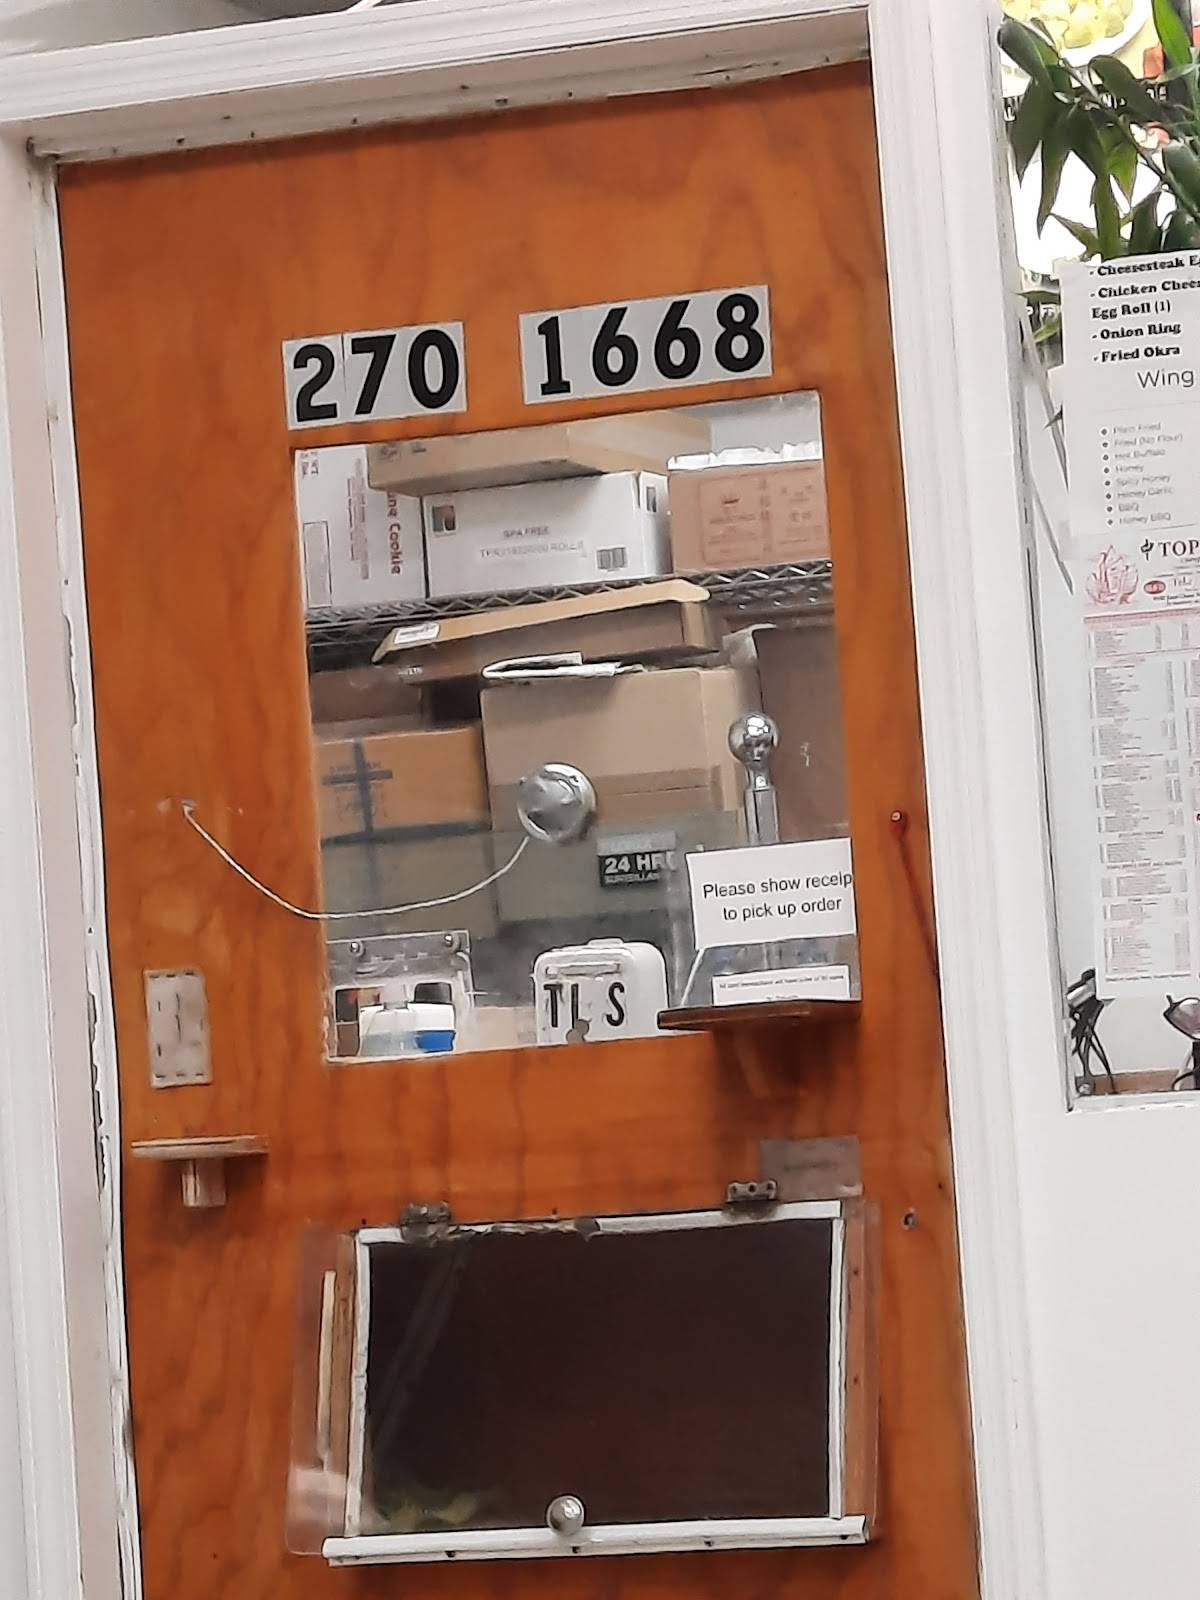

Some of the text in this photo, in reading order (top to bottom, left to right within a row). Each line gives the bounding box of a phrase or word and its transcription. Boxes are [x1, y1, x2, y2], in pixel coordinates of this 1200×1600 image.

[1098, 285, 1157, 298] Chicken
[1092, 307, 1118, 320] Egg
[1121, 302, 1151, 316] Roll
[1100, 323, 1181, 339] Onion Ring
[293, 293, 765, 422] 270 1668
[1101, 346, 1180, 362] Fried Okra
[1137, 368, 1194, 388] Wing
[1158, 539, 1200, 557] TOP
[604, 855, 631, 874] 24
[703, 882, 756, 899] Please
[760, 877, 801, 893] show
[723, 897, 842, 922] to pick up order
